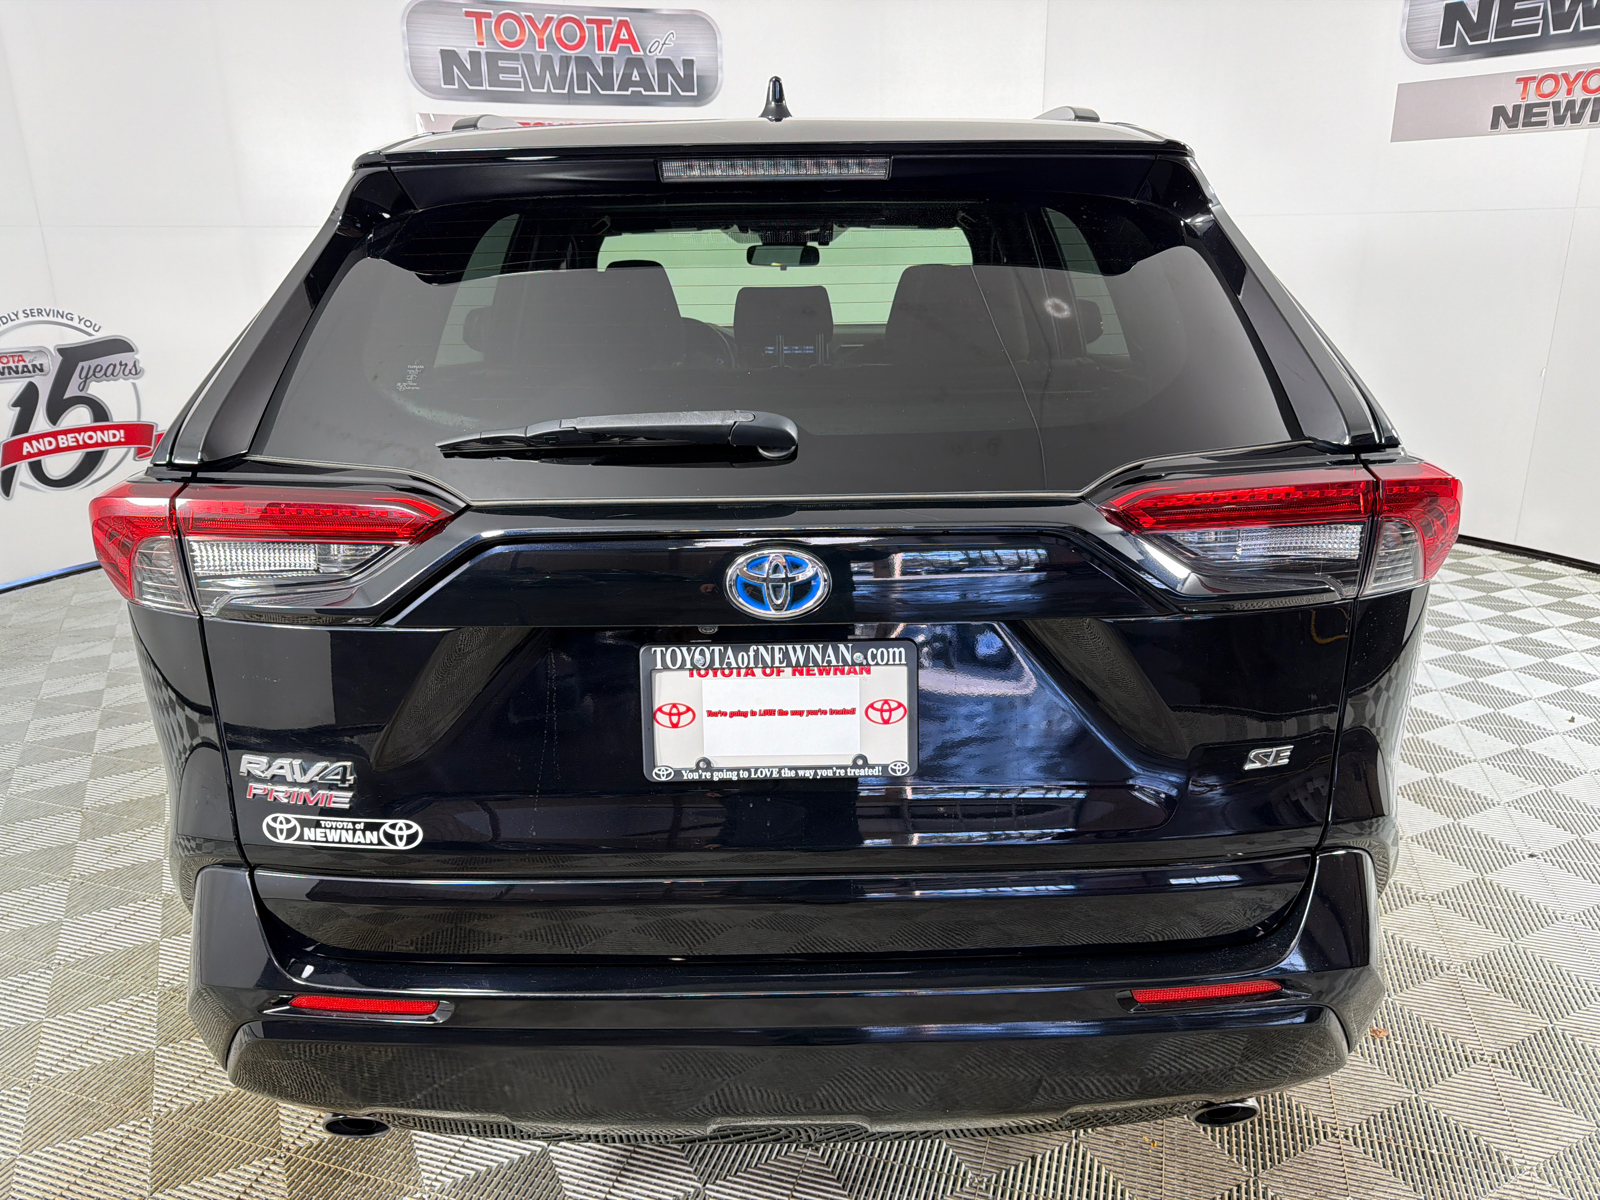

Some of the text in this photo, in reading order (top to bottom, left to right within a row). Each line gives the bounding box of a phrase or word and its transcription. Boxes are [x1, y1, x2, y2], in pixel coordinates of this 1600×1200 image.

[462, 8, 675, 56] TOYOTA of
[438, 48, 698, 96] NEWNAN
[22, 307, 75, 322] SERVING
[77, 315, 102, 333] YOU
[78, 359, 142, 392] years
[22, 429, 126, 455] AND BEYOND!
[729, 709, 749, 718] going
[758, 709, 777, 717] LOVE
[777, 709, 789, 717] the
[790, 709, 804, 717] way
[239, 754, 356, 787] RAV4
[1243, 744, 1295, 771] SE
[712, 770, 739, 781] going
[738, 768, 749, 779] to
[750, 767, 780, 778] LOVE
[780, 767, 797, 778] the
[797, 768, 816, 779] way
[846, 766, 883, 776] treated!
[246, 782, 355, 809] PRIME
[302, 827, 379, 844] NEWNAN
[319, 820, 354, 829] TOYOTA
